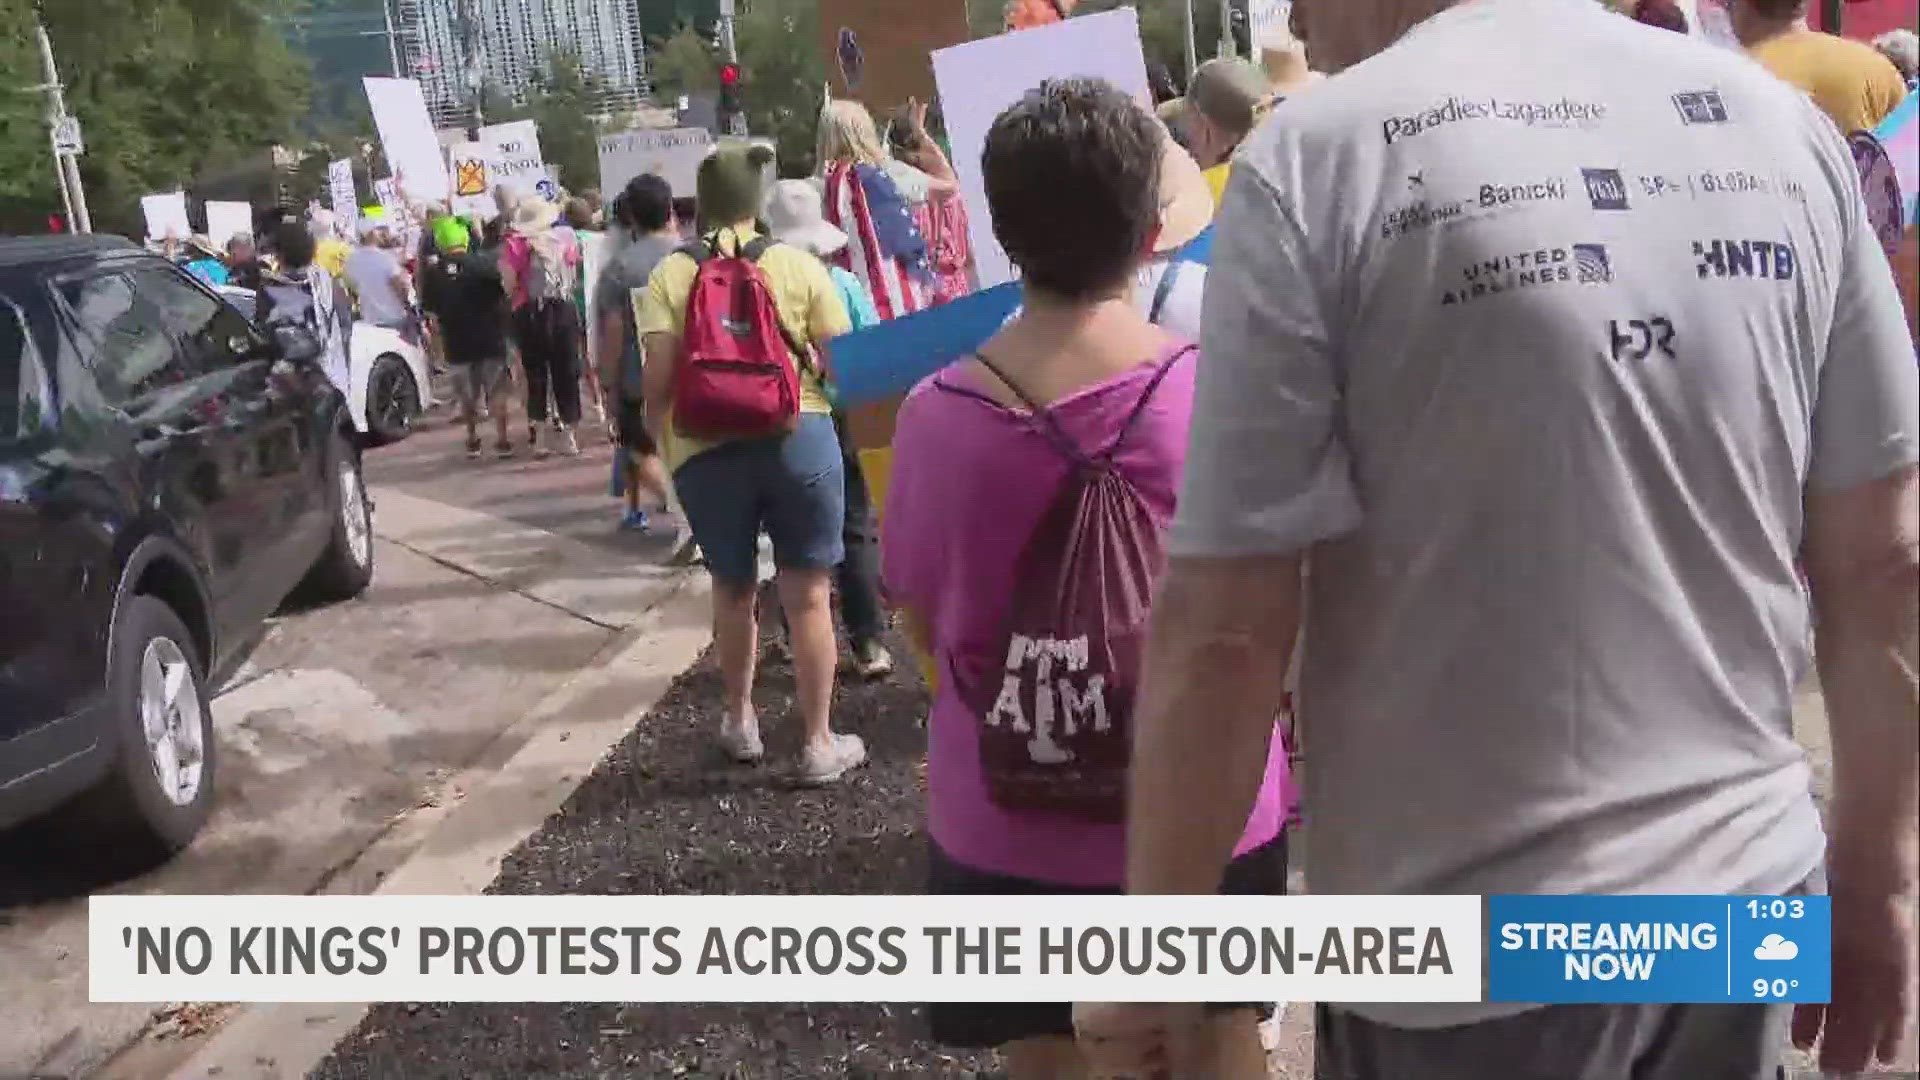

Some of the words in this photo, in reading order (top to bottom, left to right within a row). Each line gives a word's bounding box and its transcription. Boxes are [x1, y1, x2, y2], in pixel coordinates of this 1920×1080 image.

[1463, 248, 1566, 281] UNITED
[1691, 239, 1794, 281] HNTB
[1610, 317, 1676, 361] HDR
